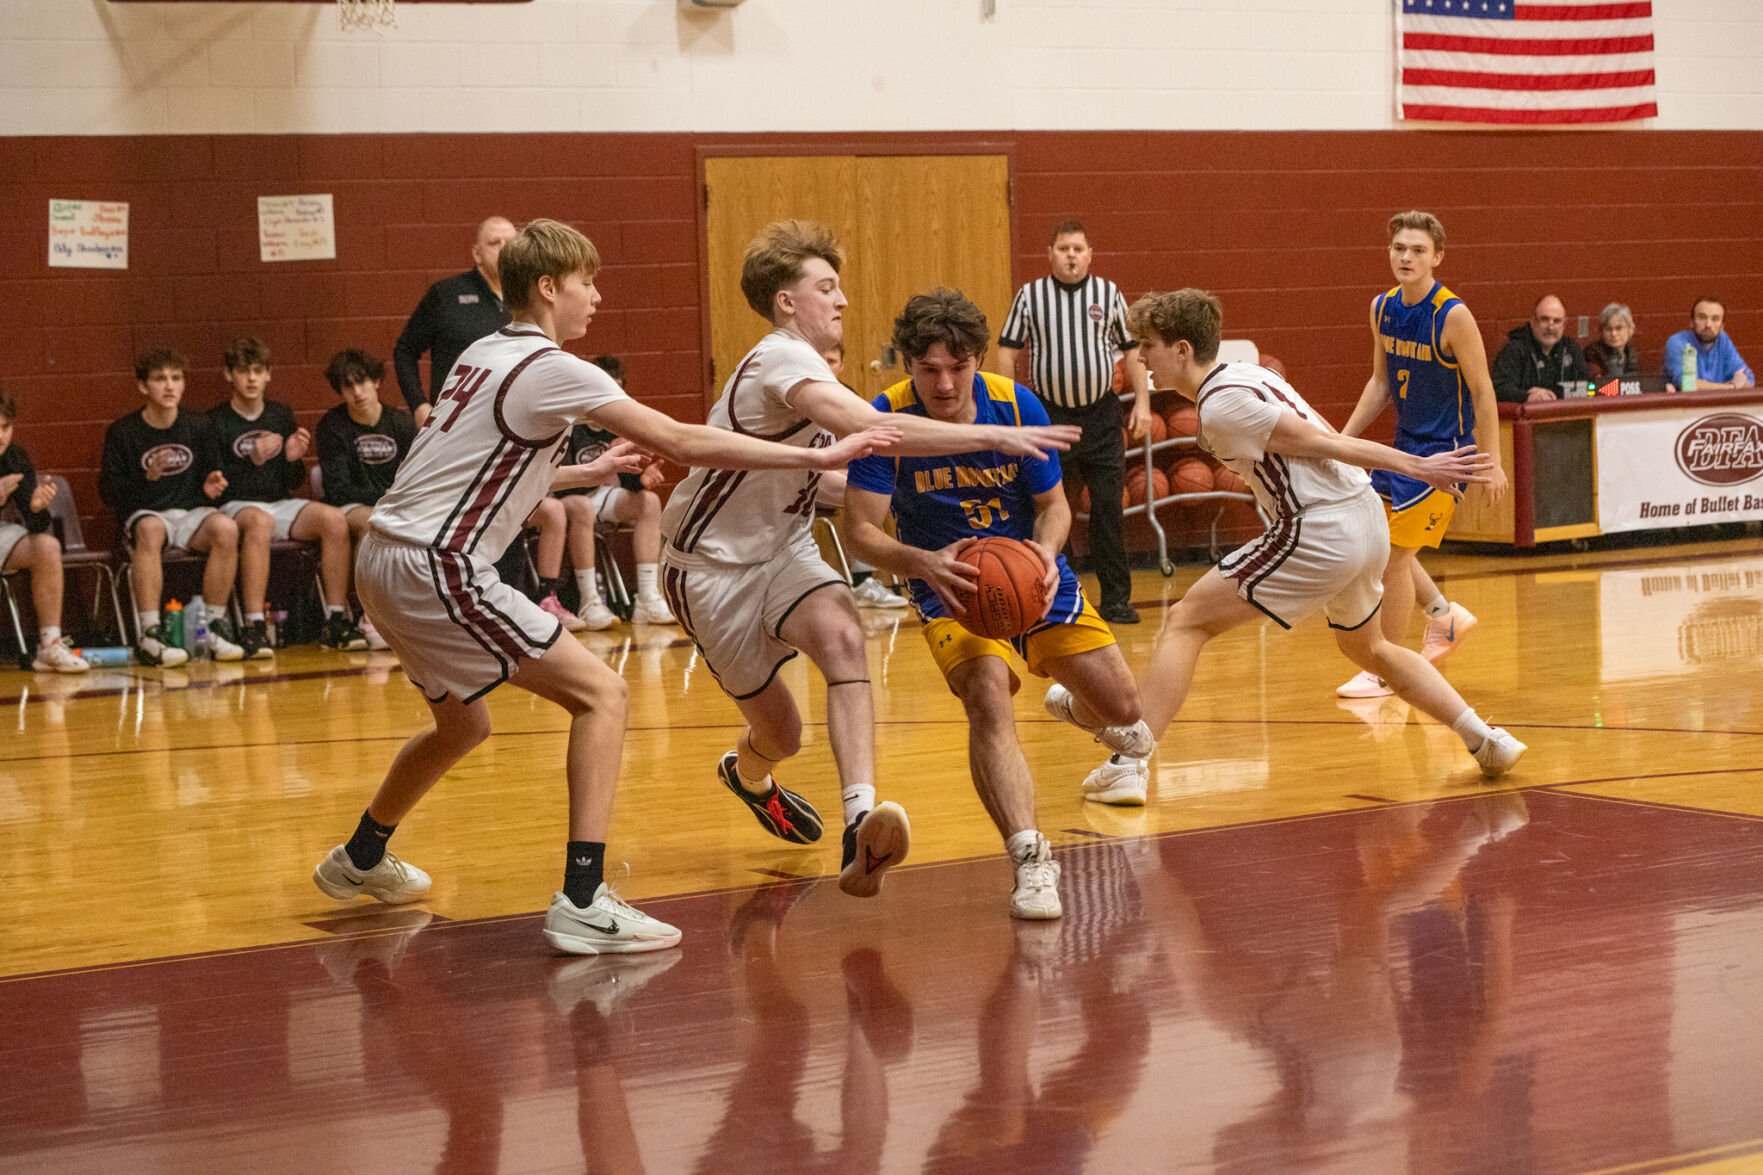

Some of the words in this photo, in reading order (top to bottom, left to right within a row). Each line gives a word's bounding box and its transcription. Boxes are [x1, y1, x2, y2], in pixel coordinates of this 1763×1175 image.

[1397, 369, 1410, 400] 2
[914, 467, 954, 493] BLUE
[1639, 502, 1680, 518] Home
[1685, 498, 1697, 515] of
[1700, 496, 1740, 513] Bullet
